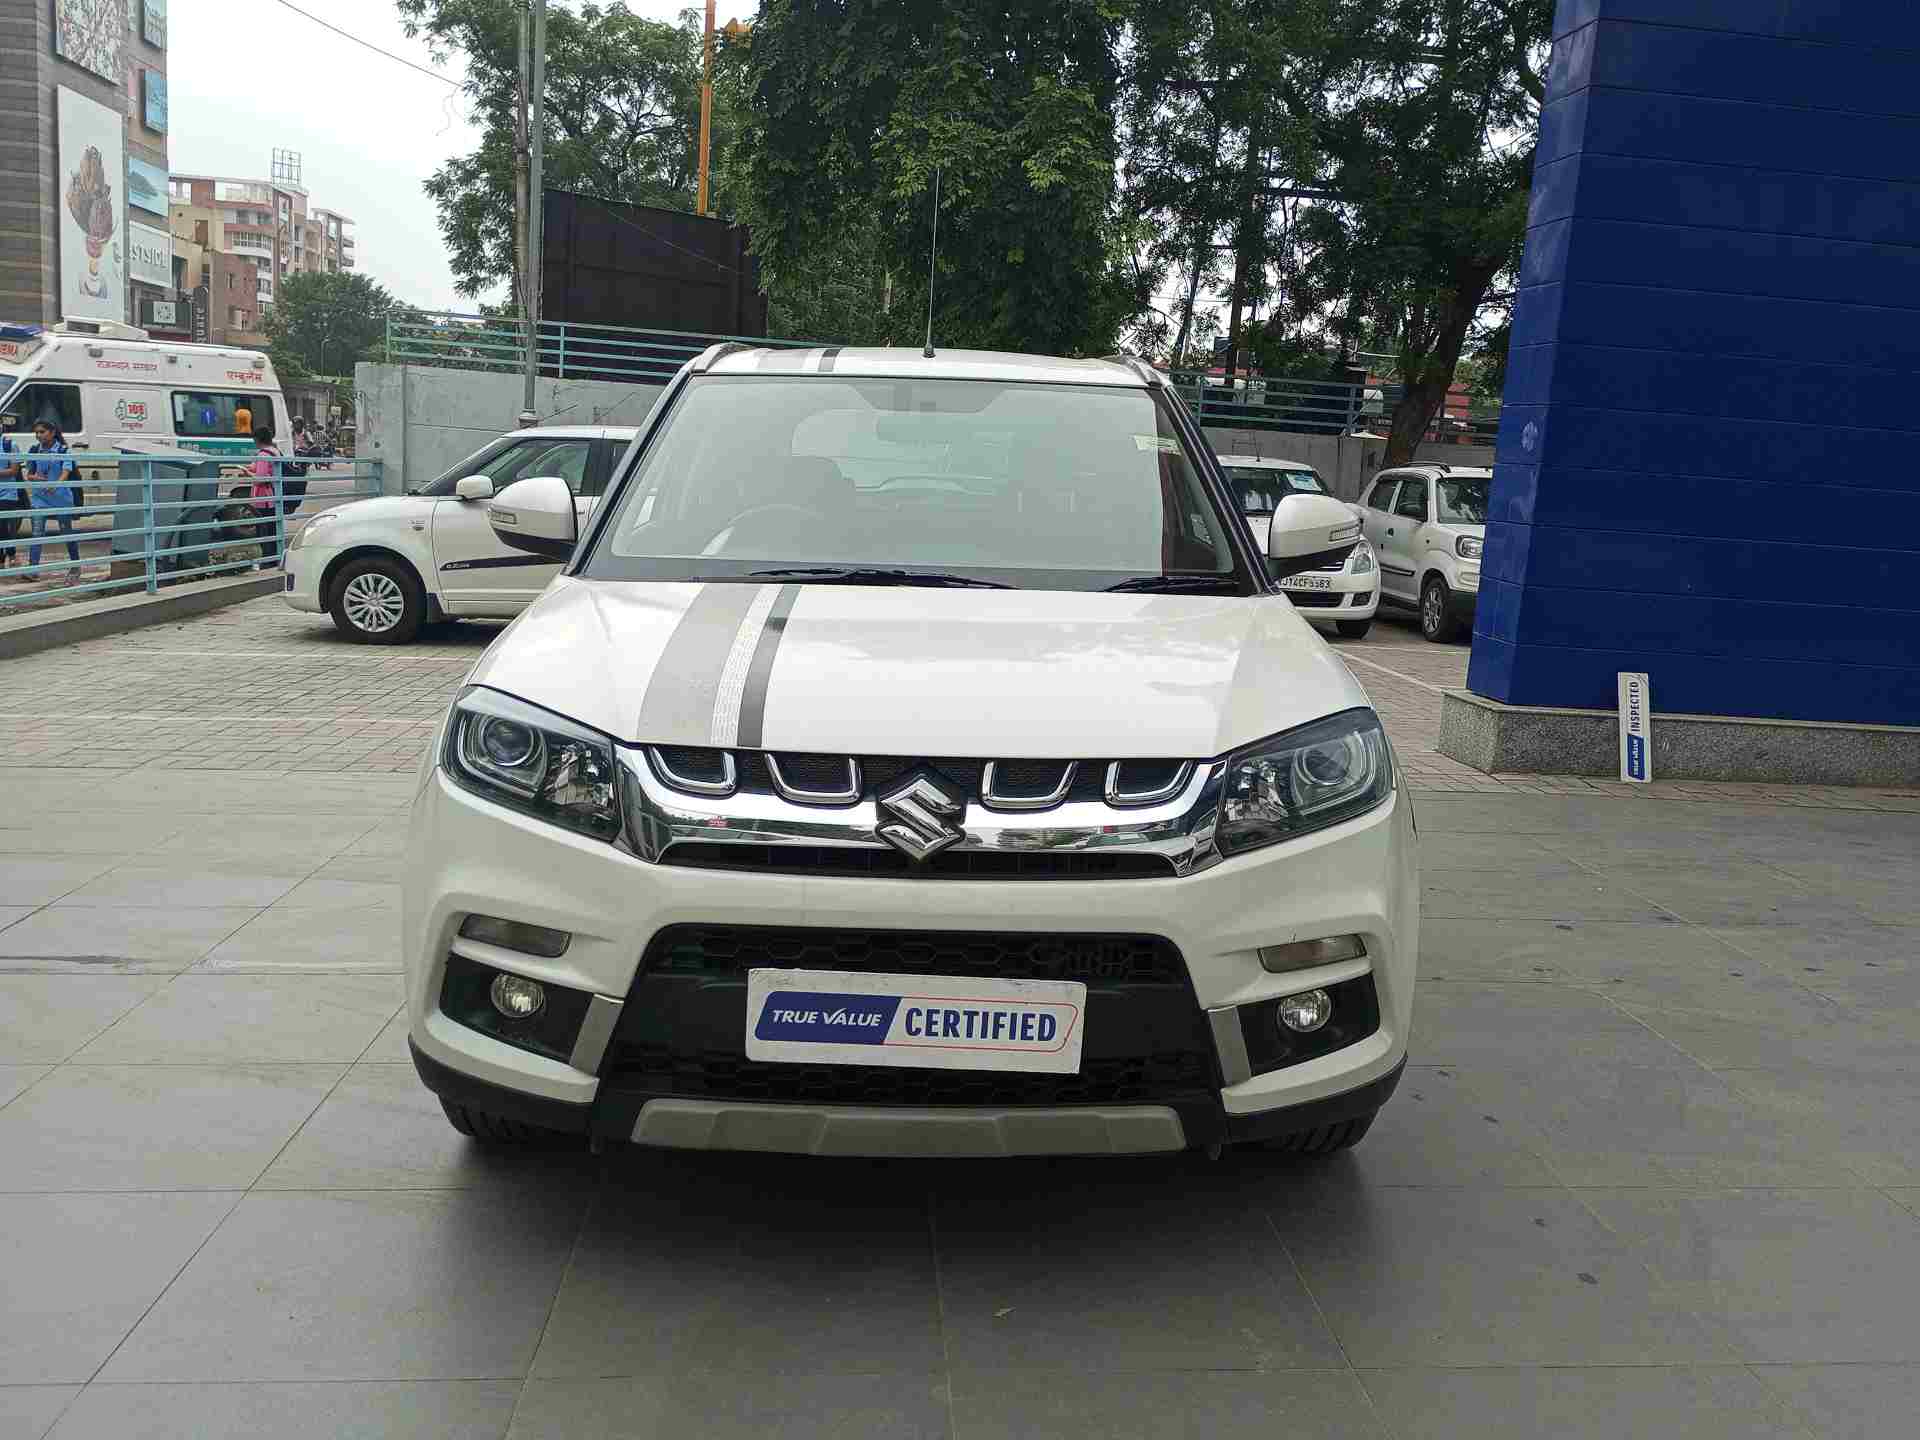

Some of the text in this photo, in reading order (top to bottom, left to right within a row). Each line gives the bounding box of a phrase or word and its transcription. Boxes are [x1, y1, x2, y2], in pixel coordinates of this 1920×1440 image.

[1629, 681, 1641, 732] INSPECTED
[772, 1006, 1057, 1042] TRUE VALUE CERTIFIED
